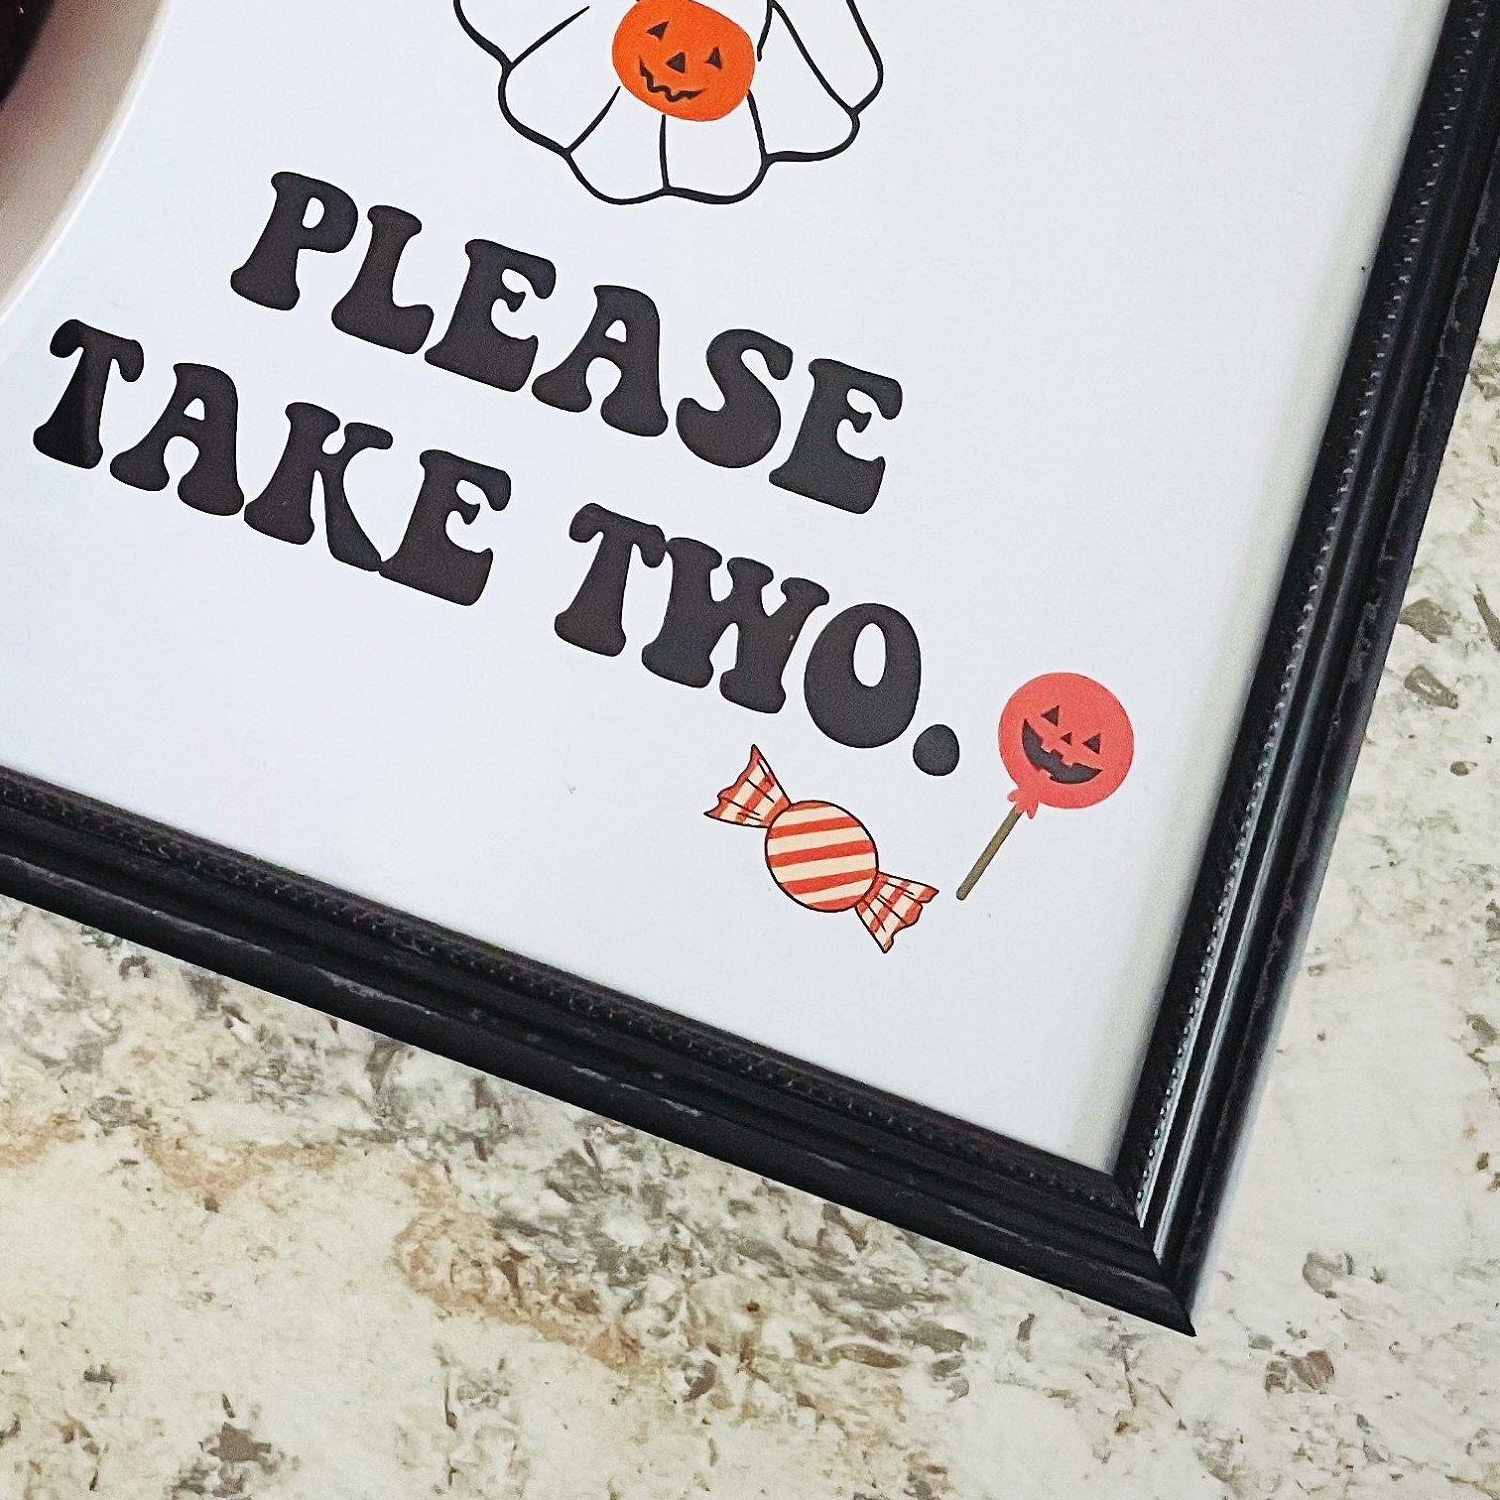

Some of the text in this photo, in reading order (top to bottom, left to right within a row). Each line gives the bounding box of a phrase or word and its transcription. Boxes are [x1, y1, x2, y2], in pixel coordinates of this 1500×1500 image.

[230, 172, 902, 514] PLEASE
[33, 319, 959, 776] TAKE TWO.
